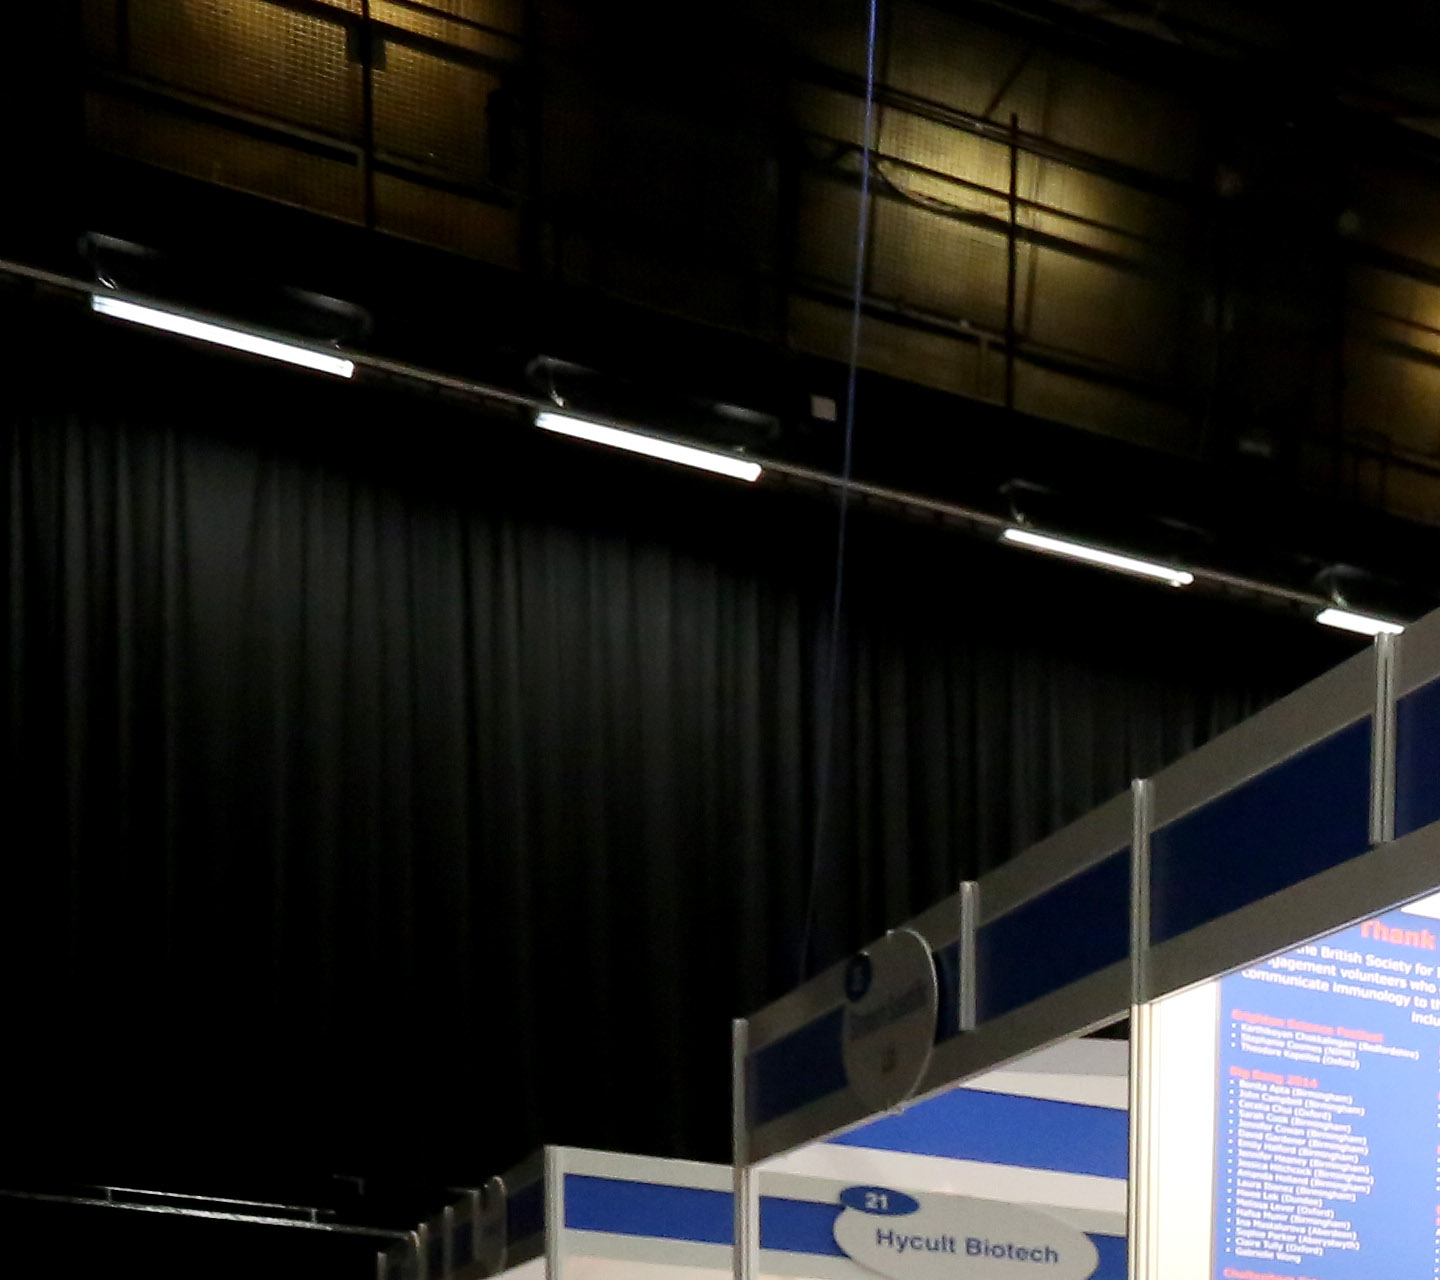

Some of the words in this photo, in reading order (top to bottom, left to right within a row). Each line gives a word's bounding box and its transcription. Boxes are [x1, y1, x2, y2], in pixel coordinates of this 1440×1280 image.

[1360, 920, 1436, 950] Thank
[1321, 946, 1363, 964] British
[1366, 954, 1411, 974] Society
[1416, 962, 1433, 977] for
[1241, 969, 1329, 992] communicate
[1333, 981, 1411, 1007] immunology
[1414, 996, 1427, 1008] to
[1340, 967, 1407, 988] volunteers
[1410, 980, 1436, 994] who
[865, 1192, 888, 1210] 21
[877, 1227, 956, 1254] Hycult
[967, 1237, 1058, 1264] Biotech
